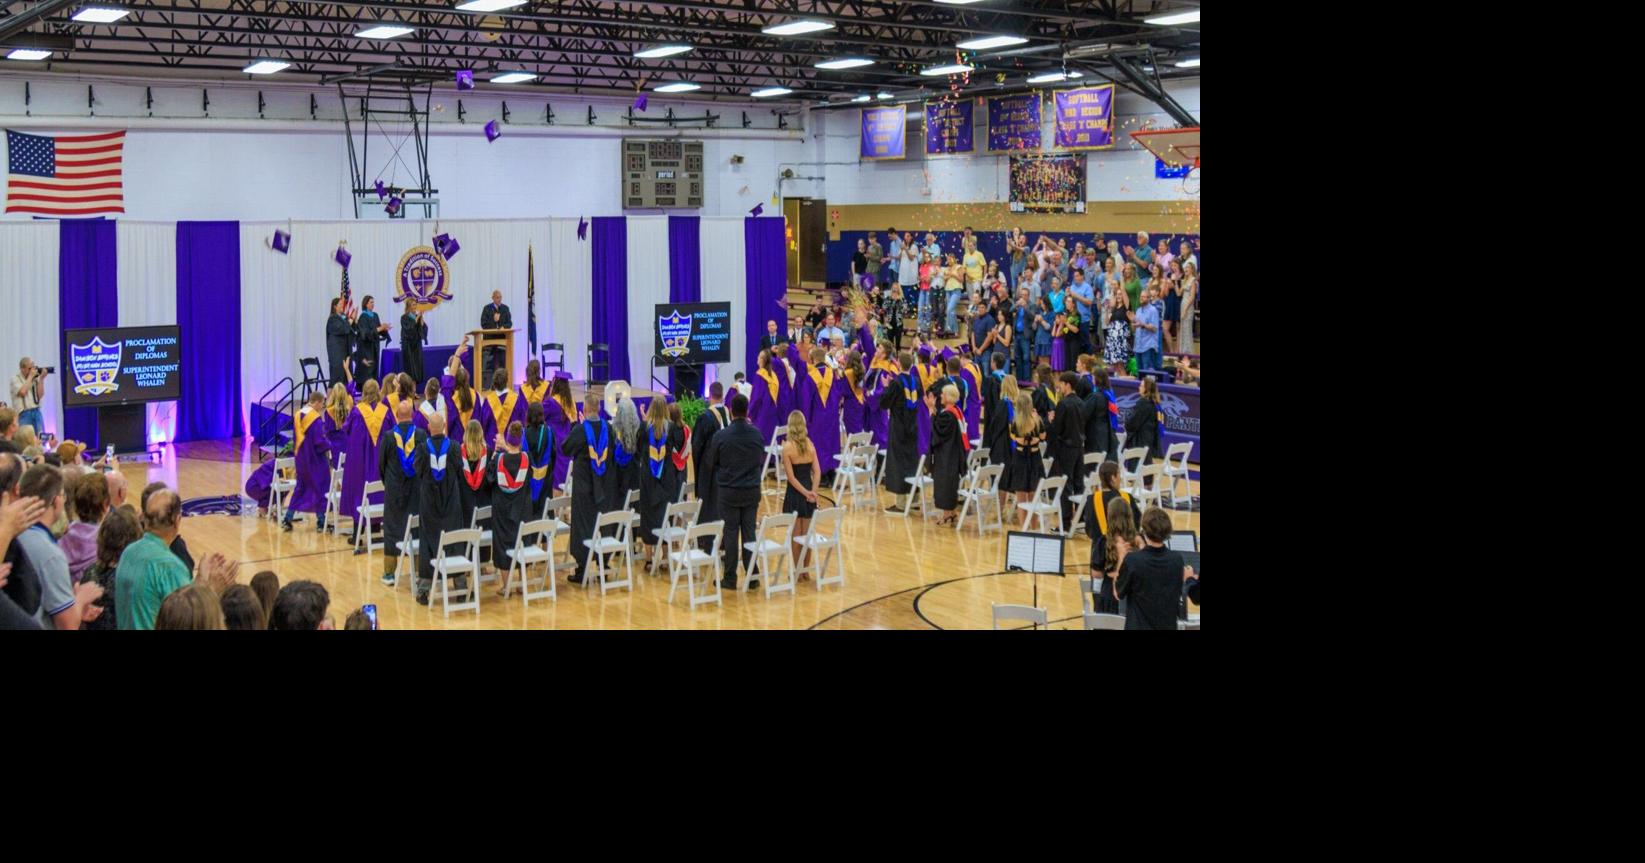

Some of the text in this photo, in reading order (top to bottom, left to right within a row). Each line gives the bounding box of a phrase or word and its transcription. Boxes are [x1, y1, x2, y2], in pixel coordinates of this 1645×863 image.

[1068, 93, 1098, 104] SOFTBALL
[126, 338, 176, 347] PROCLAMATION
[135, 352, 168, 360] DIPLOMAS
[123, 364, 178, 374] SUPERINTENDENT
[136, 372, 167, 380] LEONARD
[137, 379, 166, 387] WHALEN
